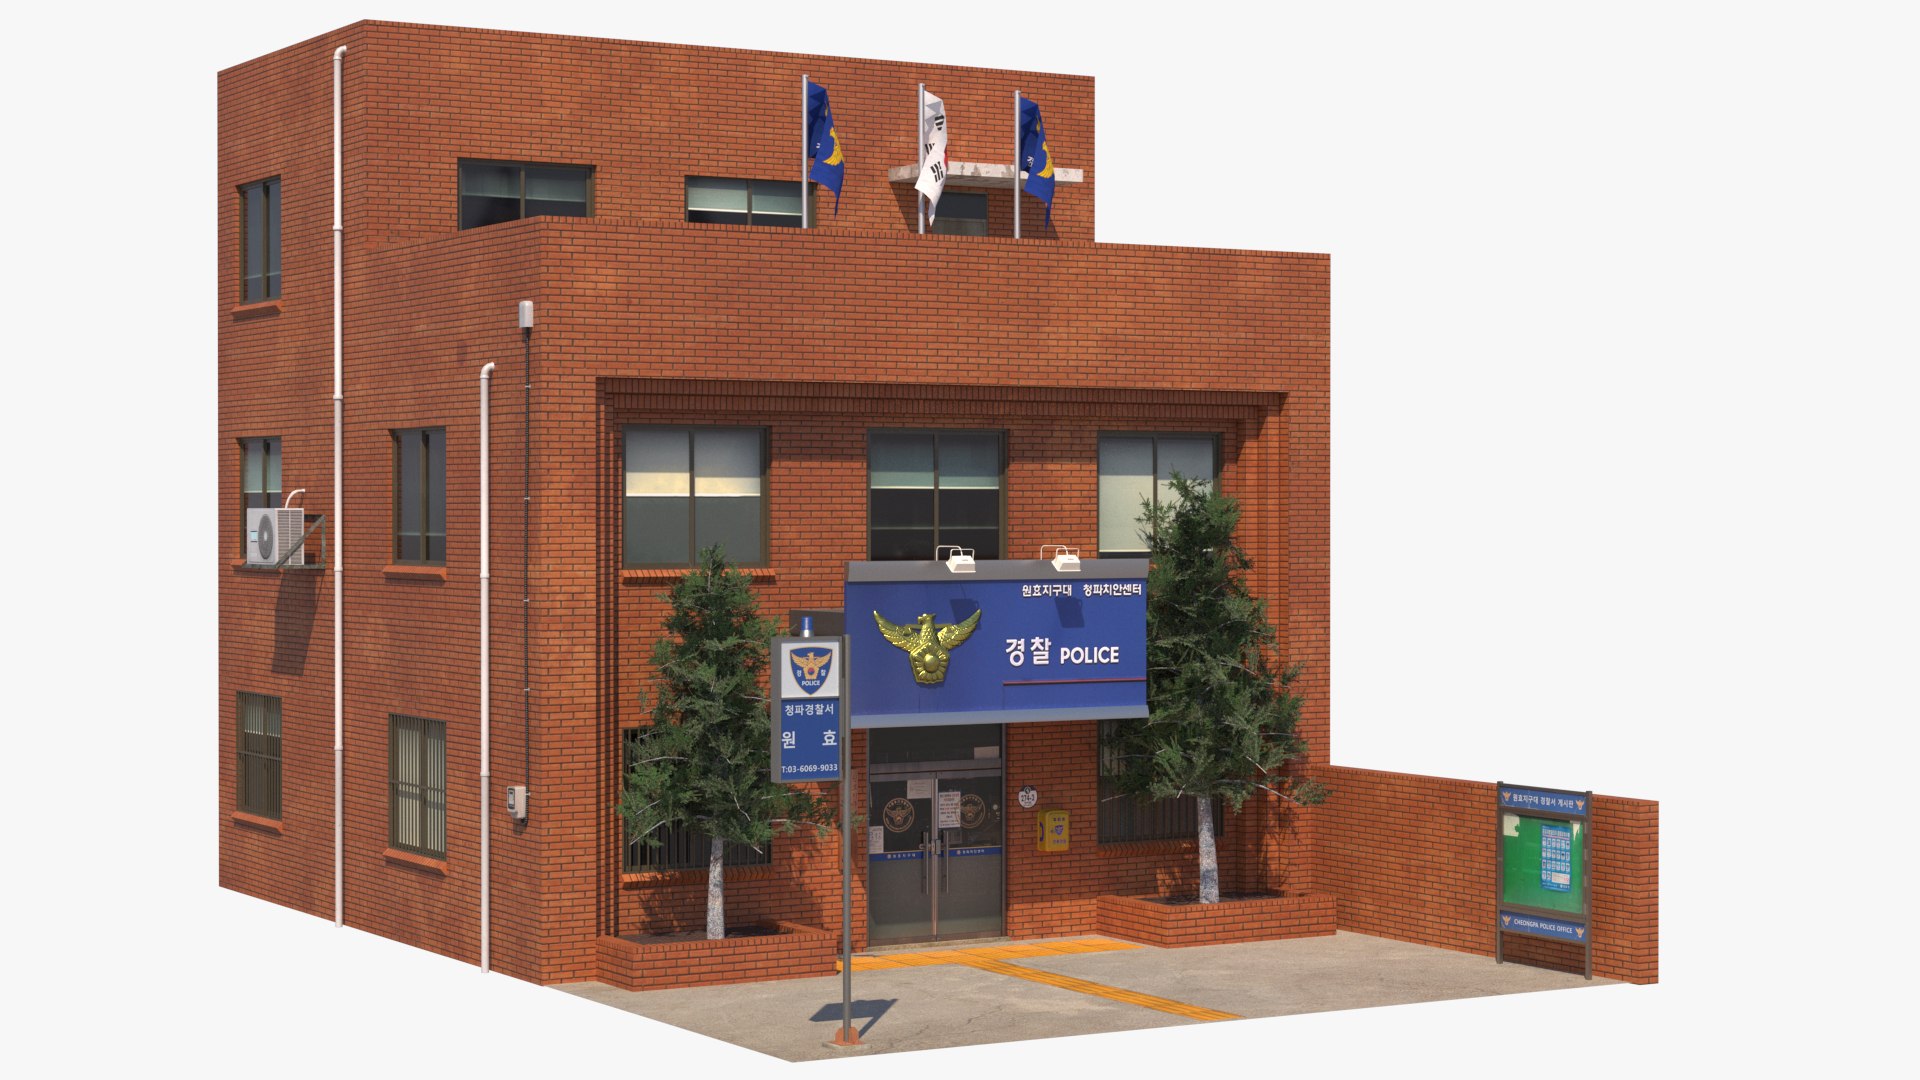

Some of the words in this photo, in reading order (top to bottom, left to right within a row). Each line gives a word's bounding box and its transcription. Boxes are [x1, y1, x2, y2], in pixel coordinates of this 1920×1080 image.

[1022, 584, 1072, 597] 원효지구대
[1083, 583, 1142, 597] 청파치안센터
[1005, 637, 1052, 667] 경찰
[1060, 646, 1119, 664] POLICE
[785, 704, 834, 716] 청파경찰서
[781, 764, 838, 774] T:03-6069-9033
[1539, 922, 1556, 931] POLICE
[1556, 926, 1573, 934] OFFICE
